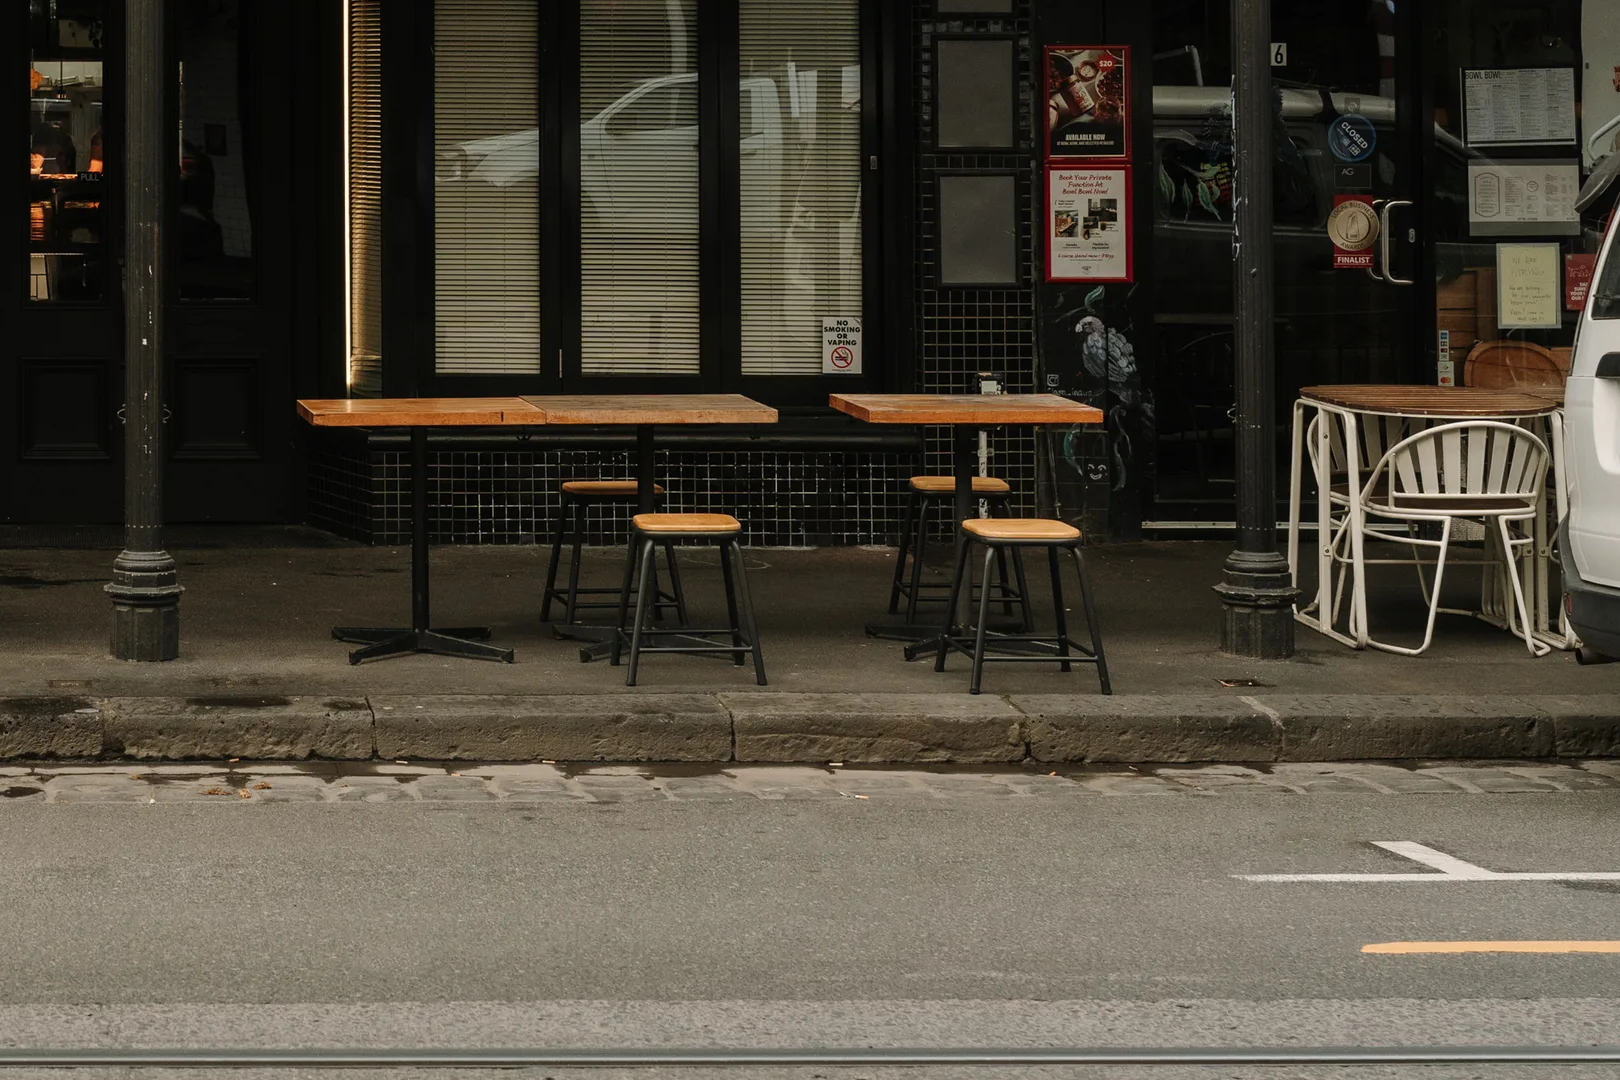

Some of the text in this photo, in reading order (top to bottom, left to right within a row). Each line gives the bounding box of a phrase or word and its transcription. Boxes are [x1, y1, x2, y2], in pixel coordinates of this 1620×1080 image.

[1274, 44, 1284, 64] 6
[1341, 122, 1368, 149] CLOSED
[1341, 167, 1355, 176] AG
[80, 173, 99, 181] PULL
[1332, 201, 1375, 220] LOCAL BUSINESS
[1340, 241, 1366, 251] AWARDS
[1337, 256, 1370, 264] FINALIST
